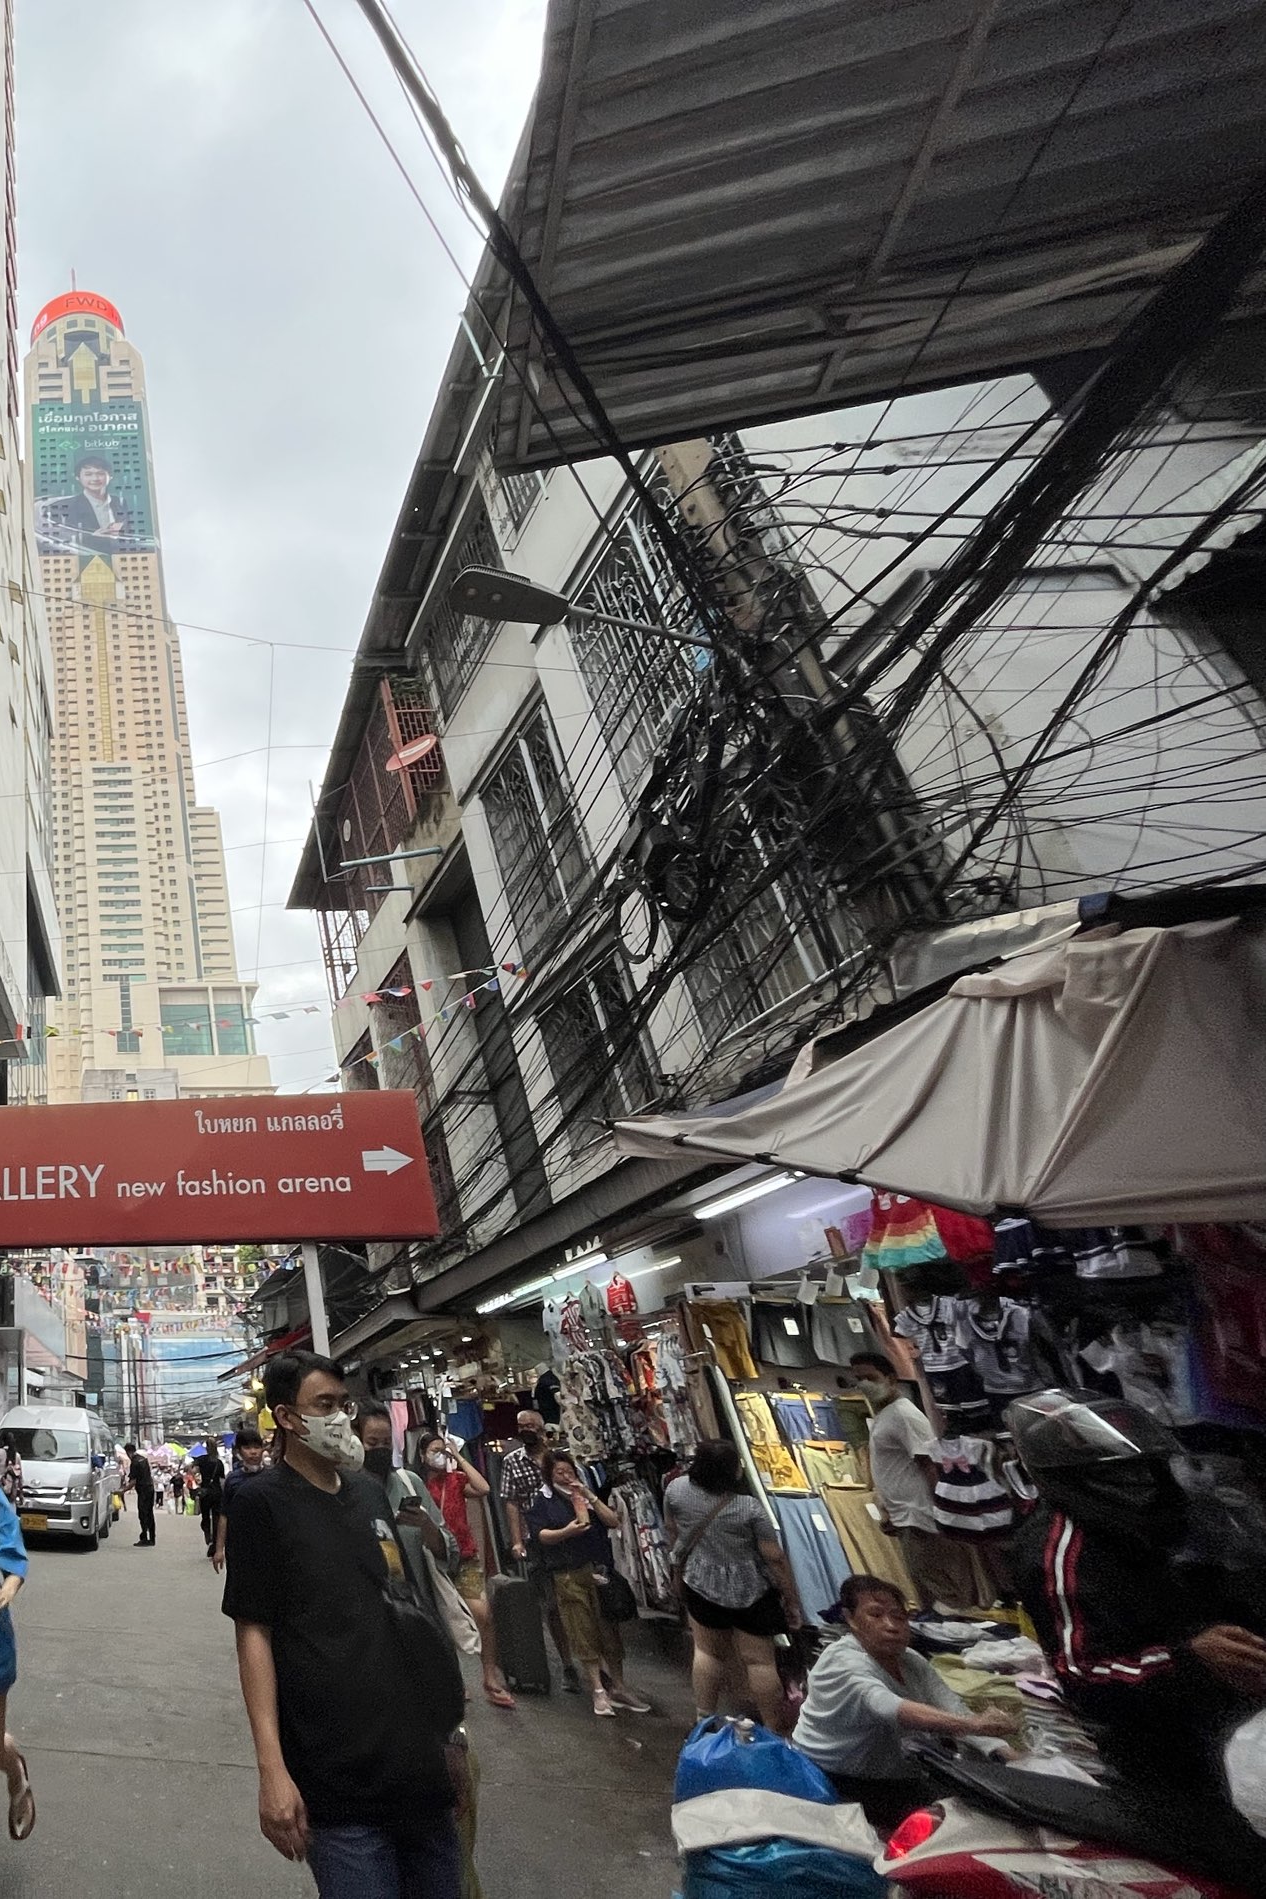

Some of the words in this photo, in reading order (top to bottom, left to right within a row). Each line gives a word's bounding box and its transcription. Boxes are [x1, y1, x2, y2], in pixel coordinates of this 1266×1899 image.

[65, 297, 107, 311] FWD
[88, 423, 138, 432] อนาคต
[84, 439, 120, 448] bitkub
[194, 1109, 258, 1135] ใบหยก
[266, 1102, 345, 1132] แกลลอรี่
[116, 1181, 167, 1198] new
[176, 1169, 266, 1196] fashion
[277, 1175, 352, 1194] arena
